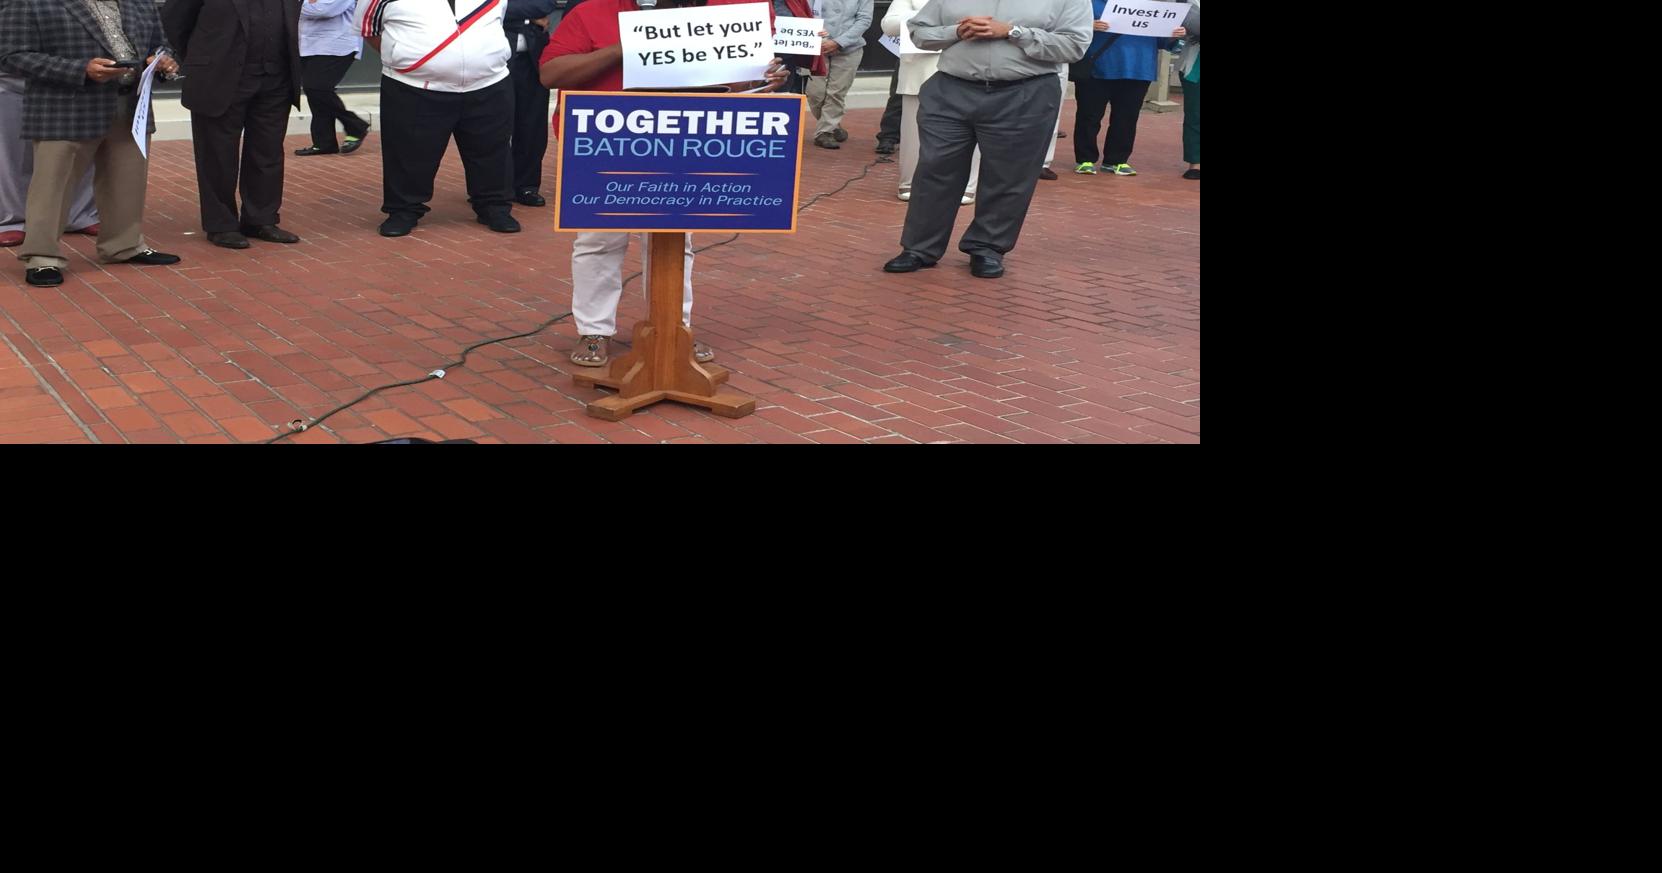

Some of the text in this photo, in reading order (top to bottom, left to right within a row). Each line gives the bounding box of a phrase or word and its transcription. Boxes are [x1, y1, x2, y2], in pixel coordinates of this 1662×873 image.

[1112, 4, 1177, 19] Invest in
[633, 20, 762, 40] “But let your
[1131, 20, 1149, 28] us
[780, 28, 815, 37] YES be
[774, 39, 788, 47] let
[638, 42, 762, 66] YES be YES.”
[571, 108, 790, 136] TOGETHER
[574, 137, 786, 158] BATON ROUGE
[606, 181, 752, 193] Our Faith in Action
[571, 194, 783, 207] Our Democracy in Practice
